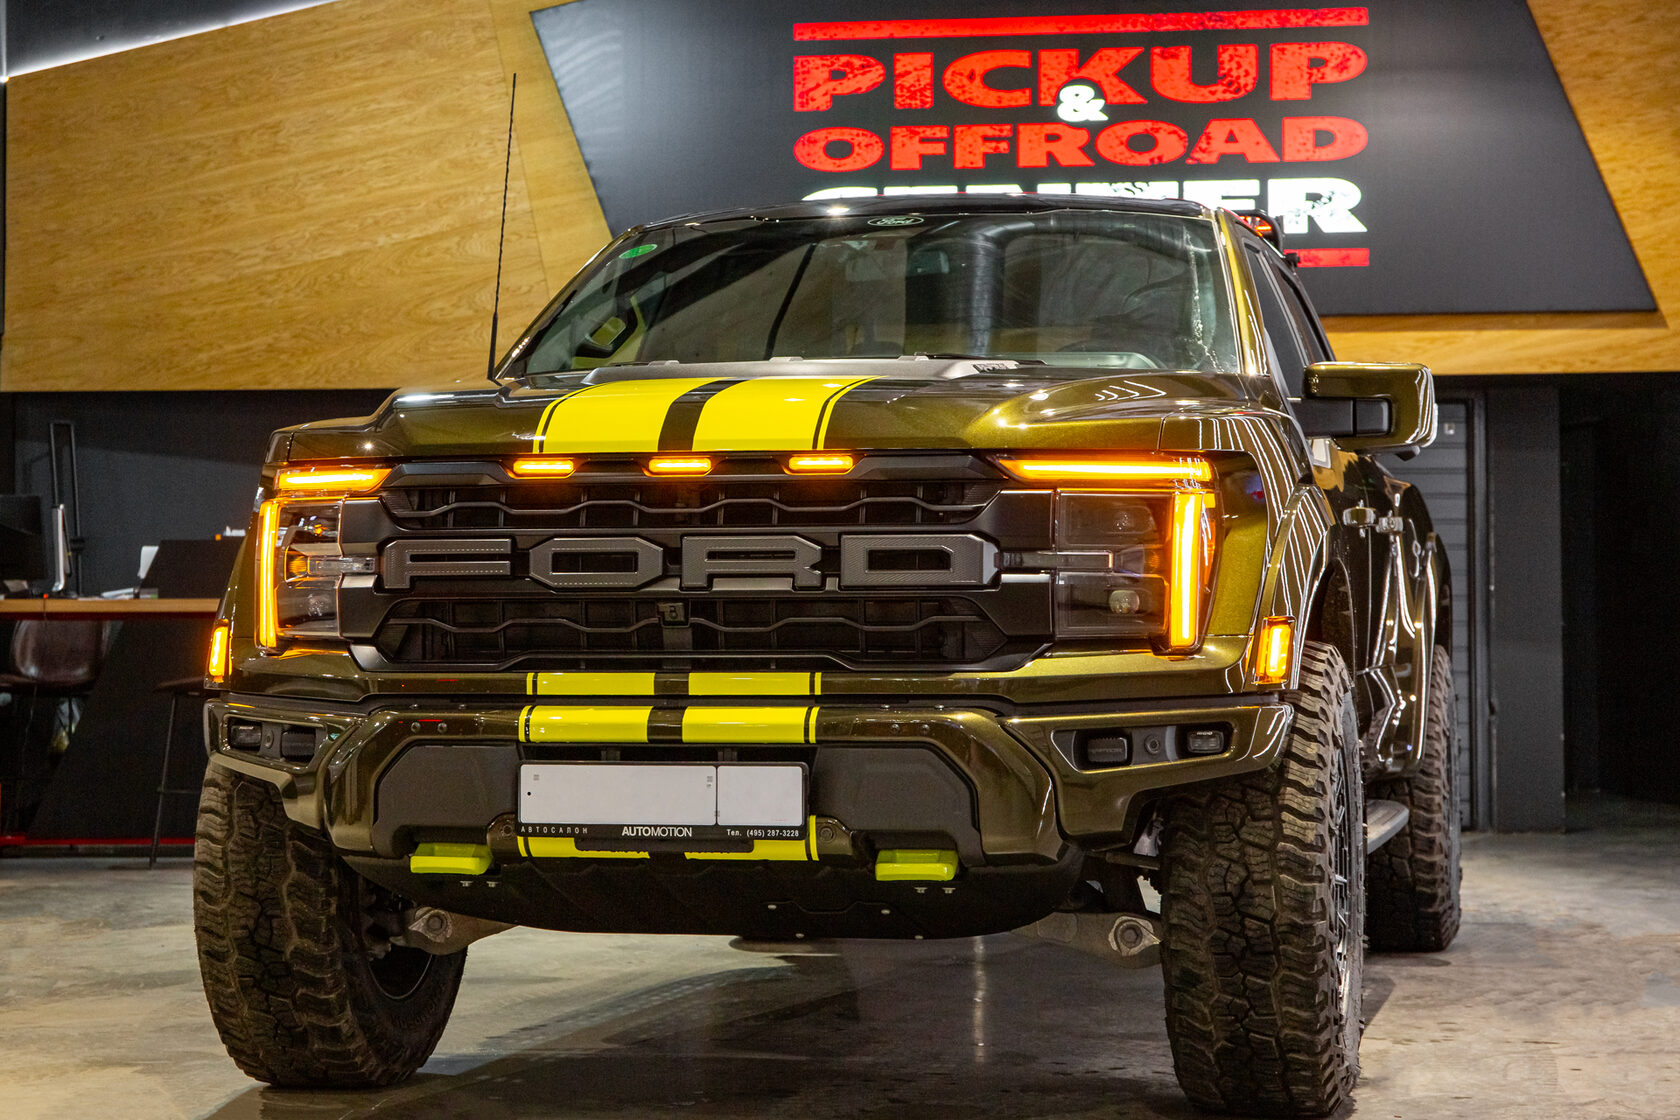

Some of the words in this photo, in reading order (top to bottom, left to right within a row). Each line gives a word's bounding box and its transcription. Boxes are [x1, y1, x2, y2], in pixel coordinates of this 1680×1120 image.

[793, 42, 1368, 111] PICKUP
[1057, 84, 1108, 122] &
[793, 116, 1369, 172] OFFROAD
[384, 533, 992, 591] FORD
[621, 826, 692, 837] AUTOMOTION
[746, 829, 765, 838] (495)
[767, 829, 799, 837] 287-3228
